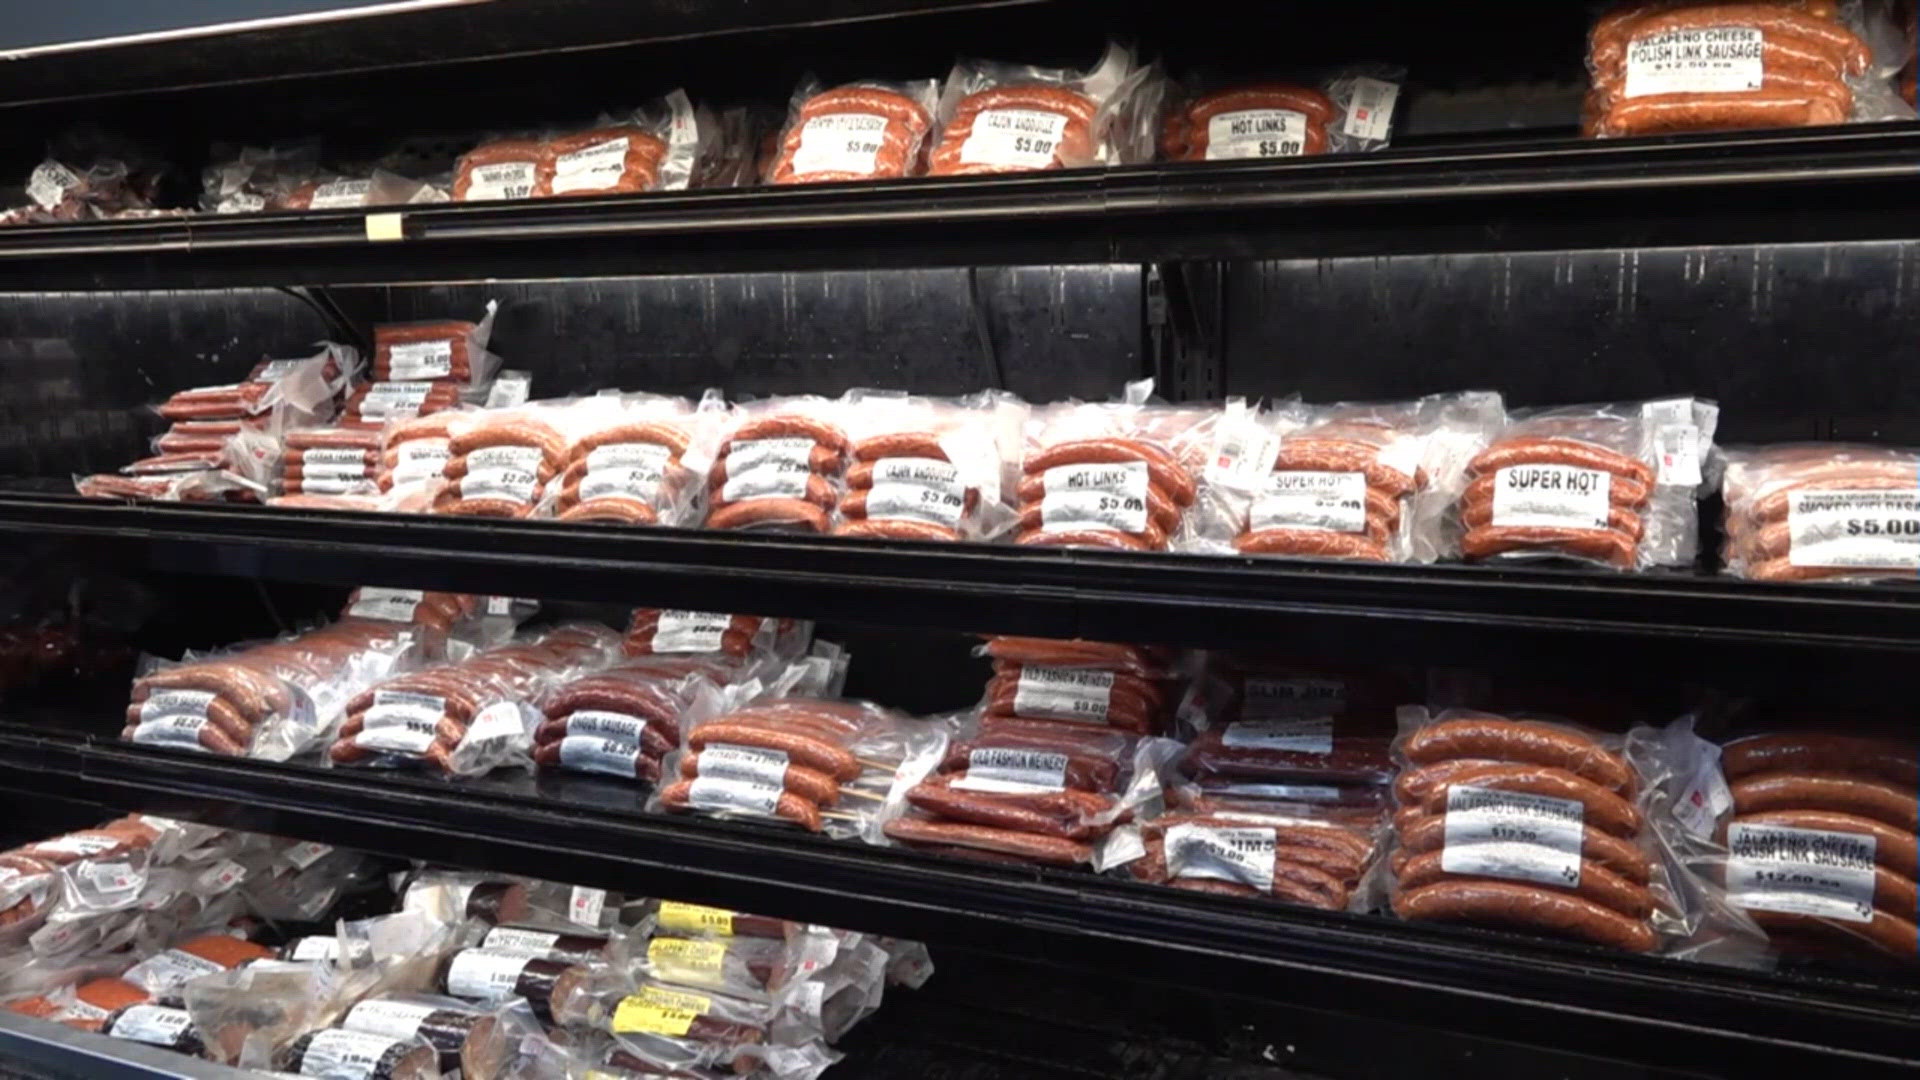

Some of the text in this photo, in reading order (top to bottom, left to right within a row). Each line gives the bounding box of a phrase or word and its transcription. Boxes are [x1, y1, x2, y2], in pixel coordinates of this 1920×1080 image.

[1636, 31, 1755, 48] JALAPENO CHEESE
[1631, 43, 1761, 63] POLISH LINK SAUSAGE
[1231, 118, 1286, 135] HOT LINKS
[1014, 136, 1053, 154] $5.00
[1259, 141, 1300, 156] $5.00
[1067, 470, 1127, 488] HOT LINKS
[1276, 475, 1314, 488] SUPER
[1508, 469, 1600, 491] SUPER HOT
[1846, 519, 1920, 536] $5.00
[1449, 798, 1583, 822] JALAPENO LINK SAUSAGE
[1491, 827, 1537, 841] $12.50
[1734, 833, 1808, 848] JALAPENO
[1732, 845, 1875, 871] POLISH LINK SAUSAGE
[1755, 870, 1814, 884] $12.50
